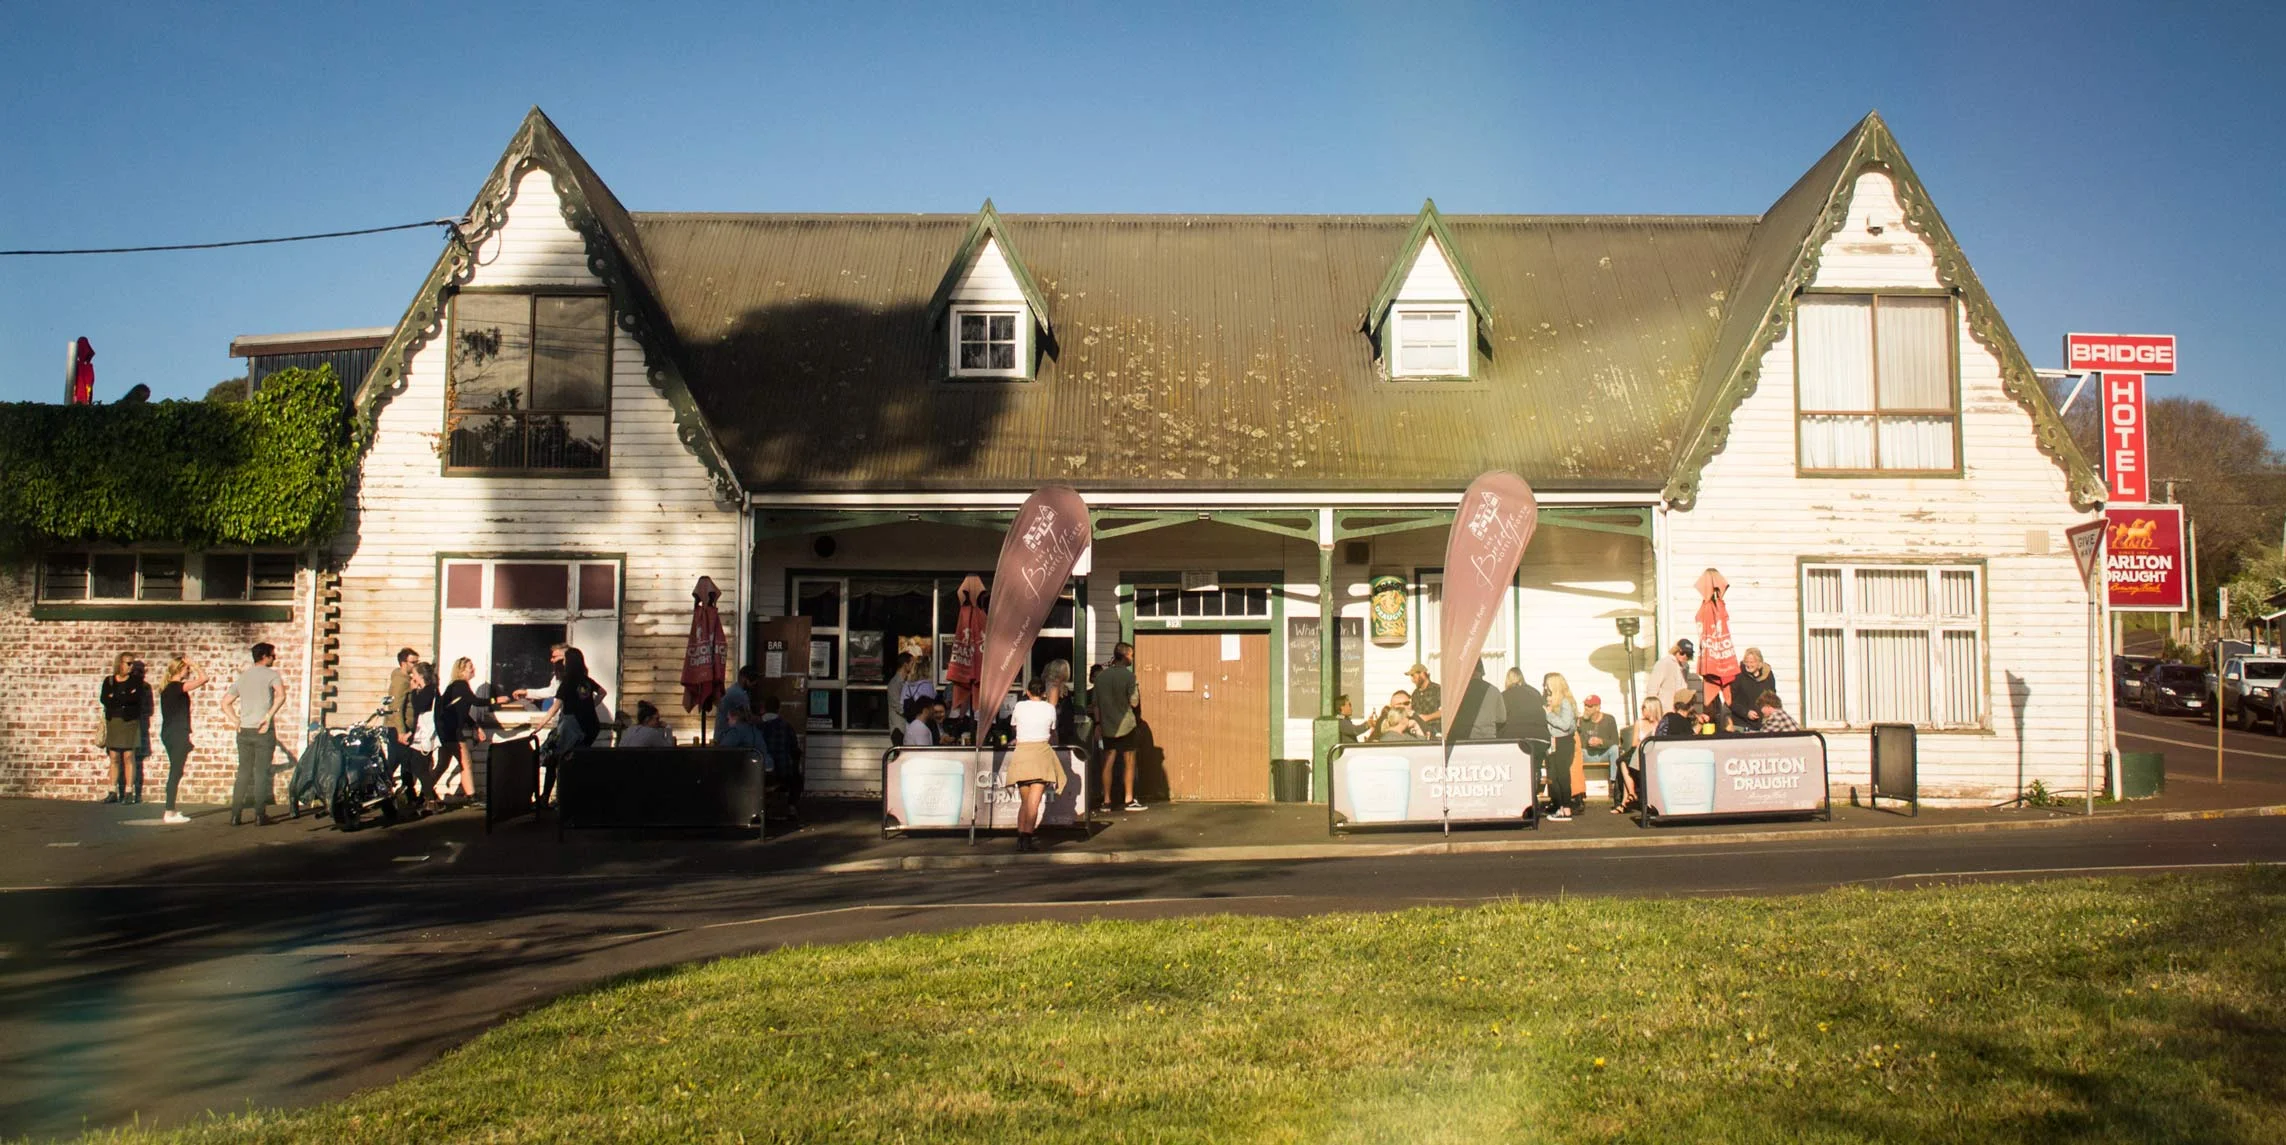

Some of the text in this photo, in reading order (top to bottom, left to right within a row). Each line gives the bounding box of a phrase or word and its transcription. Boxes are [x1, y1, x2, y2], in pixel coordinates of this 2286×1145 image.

[2072, 344, 2173, 364] BRIDGE
[2111, 381, 2136, 495] HOTEL
[2078, 533, 2096, 548] GIVE
[1471, 513, 1523, 591] Bridge
[1022, 527, 1074, 601] Bridge
[2107, 555, 2173, 570] ARLTON
[767, 641, 783, 650] BAR
[1420, 764, 1512, 784] CARLTON
[1724, 756, 1808, 776] CARLTON
[1431, 783, 1504, 799] DRAUGHT
[1733, 776, 1800, 791] DRAUGHT
